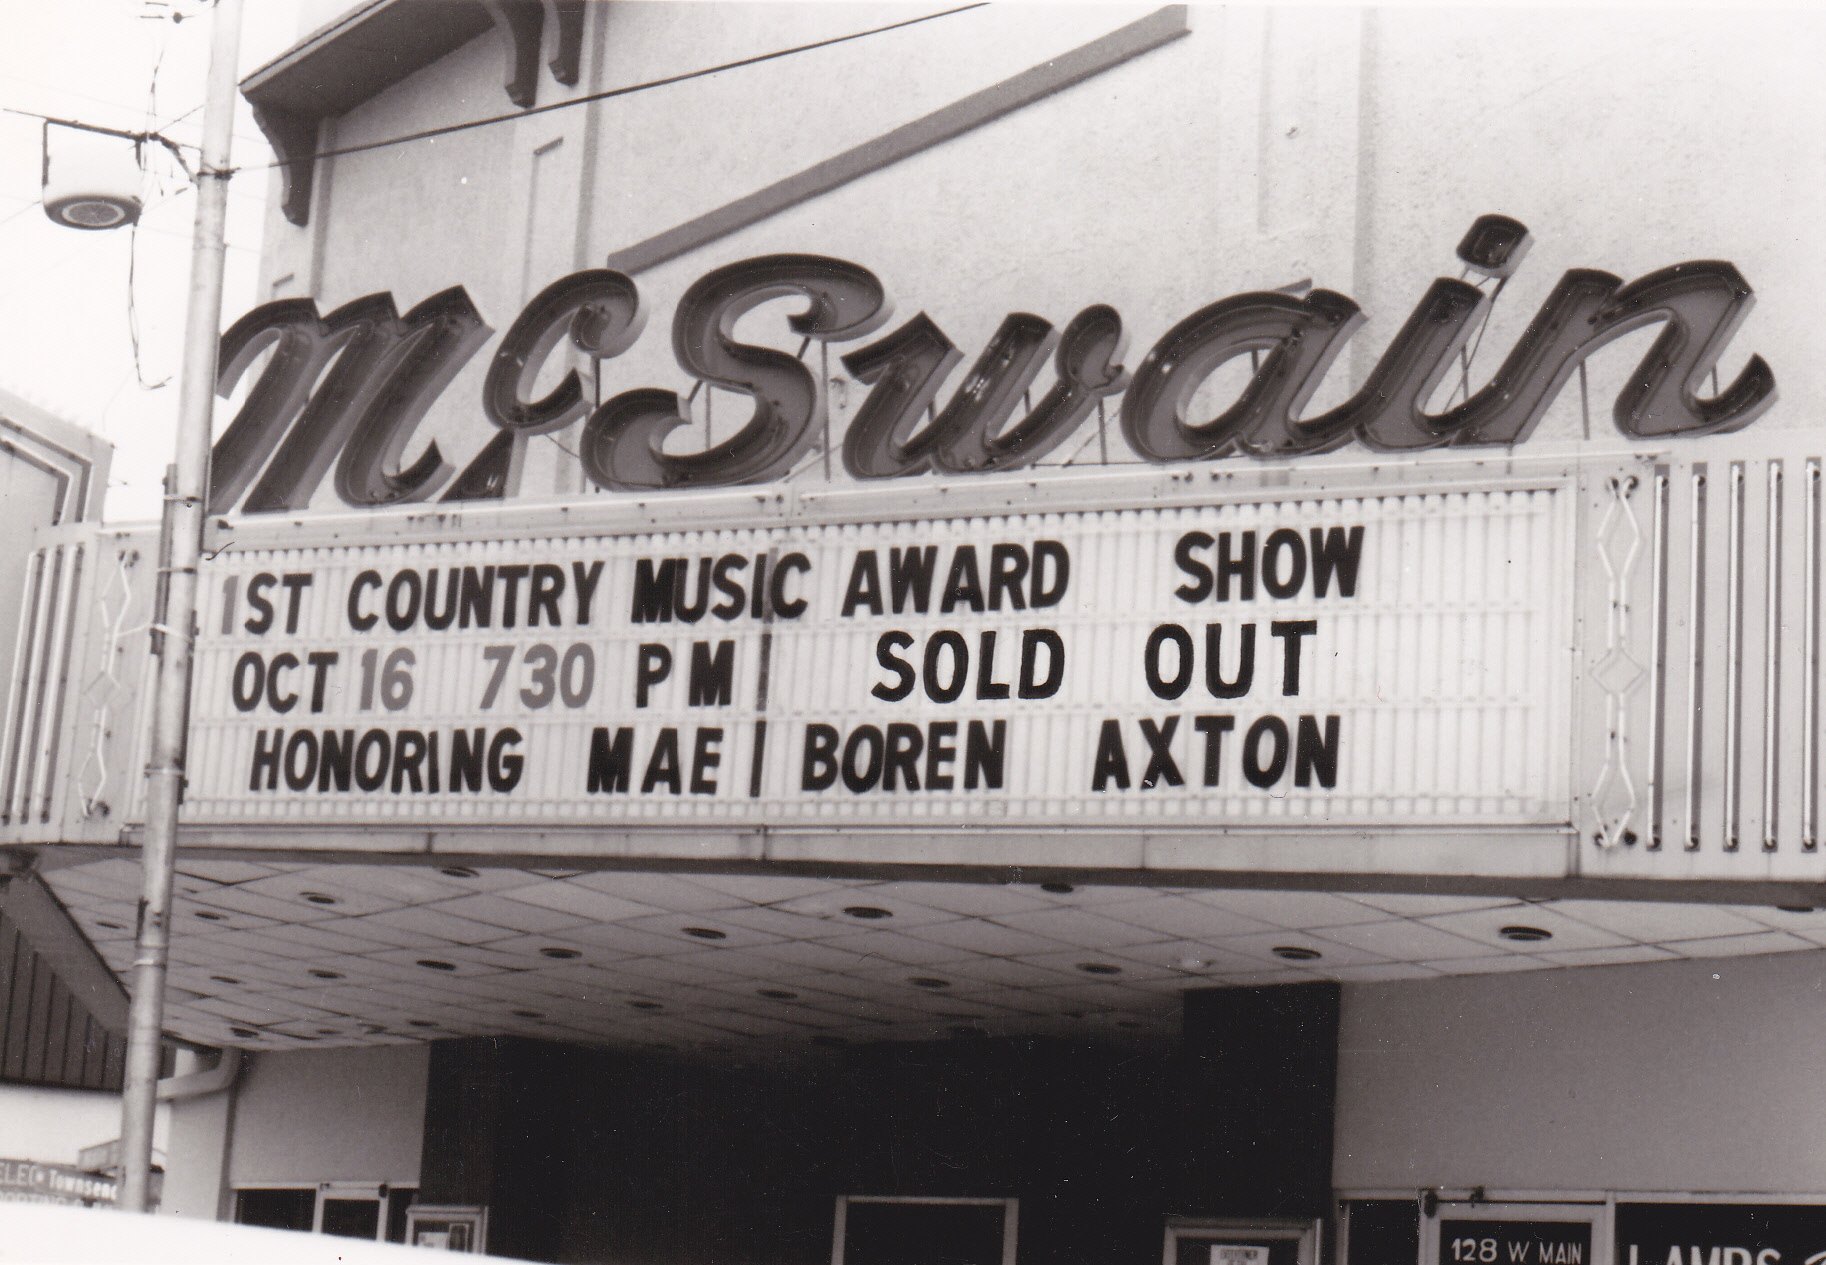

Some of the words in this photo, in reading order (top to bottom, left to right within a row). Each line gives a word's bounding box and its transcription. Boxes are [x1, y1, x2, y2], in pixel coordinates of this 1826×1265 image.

[204, 214, 1778, 512] McSwain
[221, 572, 313, 635] 1ST
[347, 560, 605, 632] COUNTRY
[631, 552, 812, 623] MUSIC
[841, 540, 1070, 617] AWARD
[1174, 525, 1365, 602] SHOW
[232, 651, 339, 713] OCT
[360, 648, 416, 711] 16
[479, 642, 596, 711] 730
[871, 628, 1065, 702] SOLD
[1144, 620, 1317, 700] OUT
[249, 727, 525, 793] HONORING
[587, 726, 724, 795] MAE
[801, 719, 1007, 793] BOREN
[1092, 715, 1340, 792] AXTON
[1451, 1237, 1498, 1263] 128
[1507, 1240, 1530, 1263] W
[1539, 1240, 1582, 1265] MAIN
